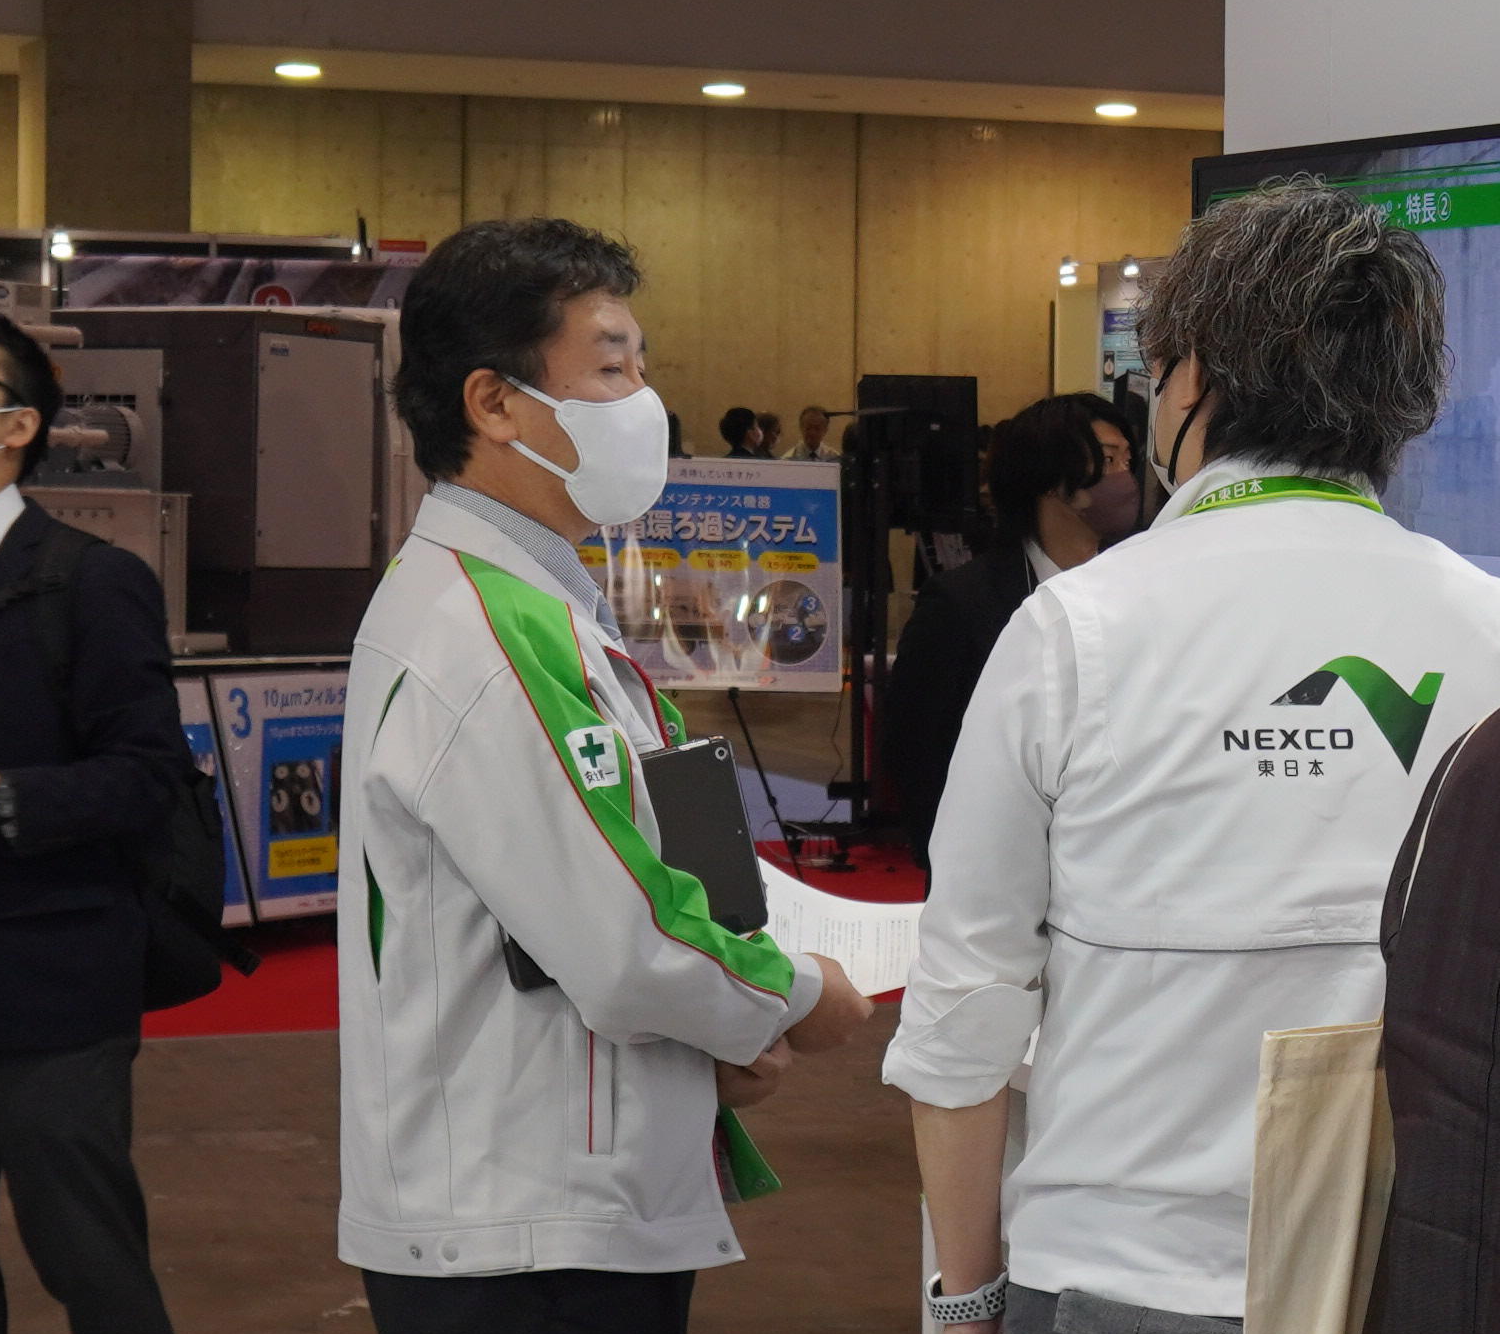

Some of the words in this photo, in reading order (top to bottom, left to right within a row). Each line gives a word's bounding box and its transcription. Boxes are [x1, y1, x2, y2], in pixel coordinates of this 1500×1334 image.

[229, 687, 251, 739] 3
[1223, 727, 1354, 752] NEXCO
[1257, 758, 1325, 778] 東日本
